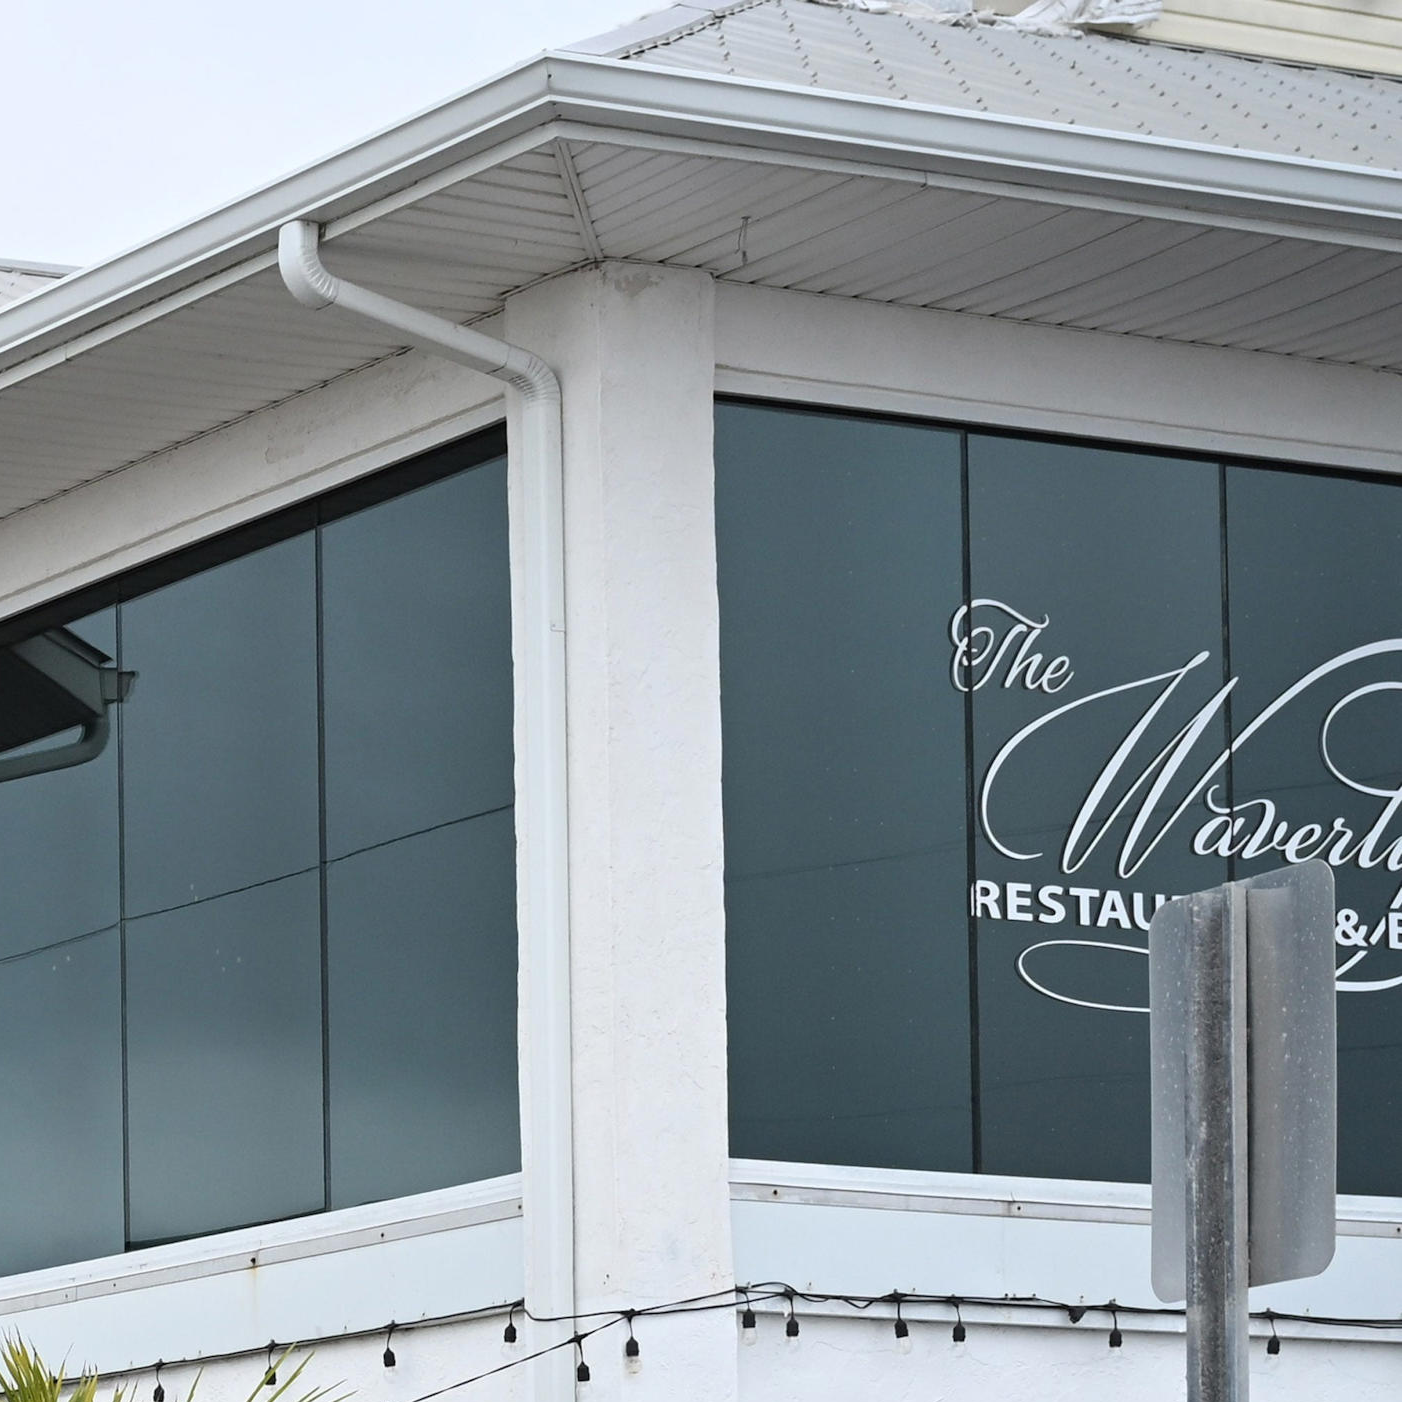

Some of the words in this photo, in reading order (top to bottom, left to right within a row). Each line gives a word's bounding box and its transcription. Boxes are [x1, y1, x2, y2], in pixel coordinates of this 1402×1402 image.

[950, 598, 1074, 693] The
[981, 638, 1402, 884] Waverl
[971, 880, 1184, 930] RESTAU
[1334, 908, 1369, 947] &
